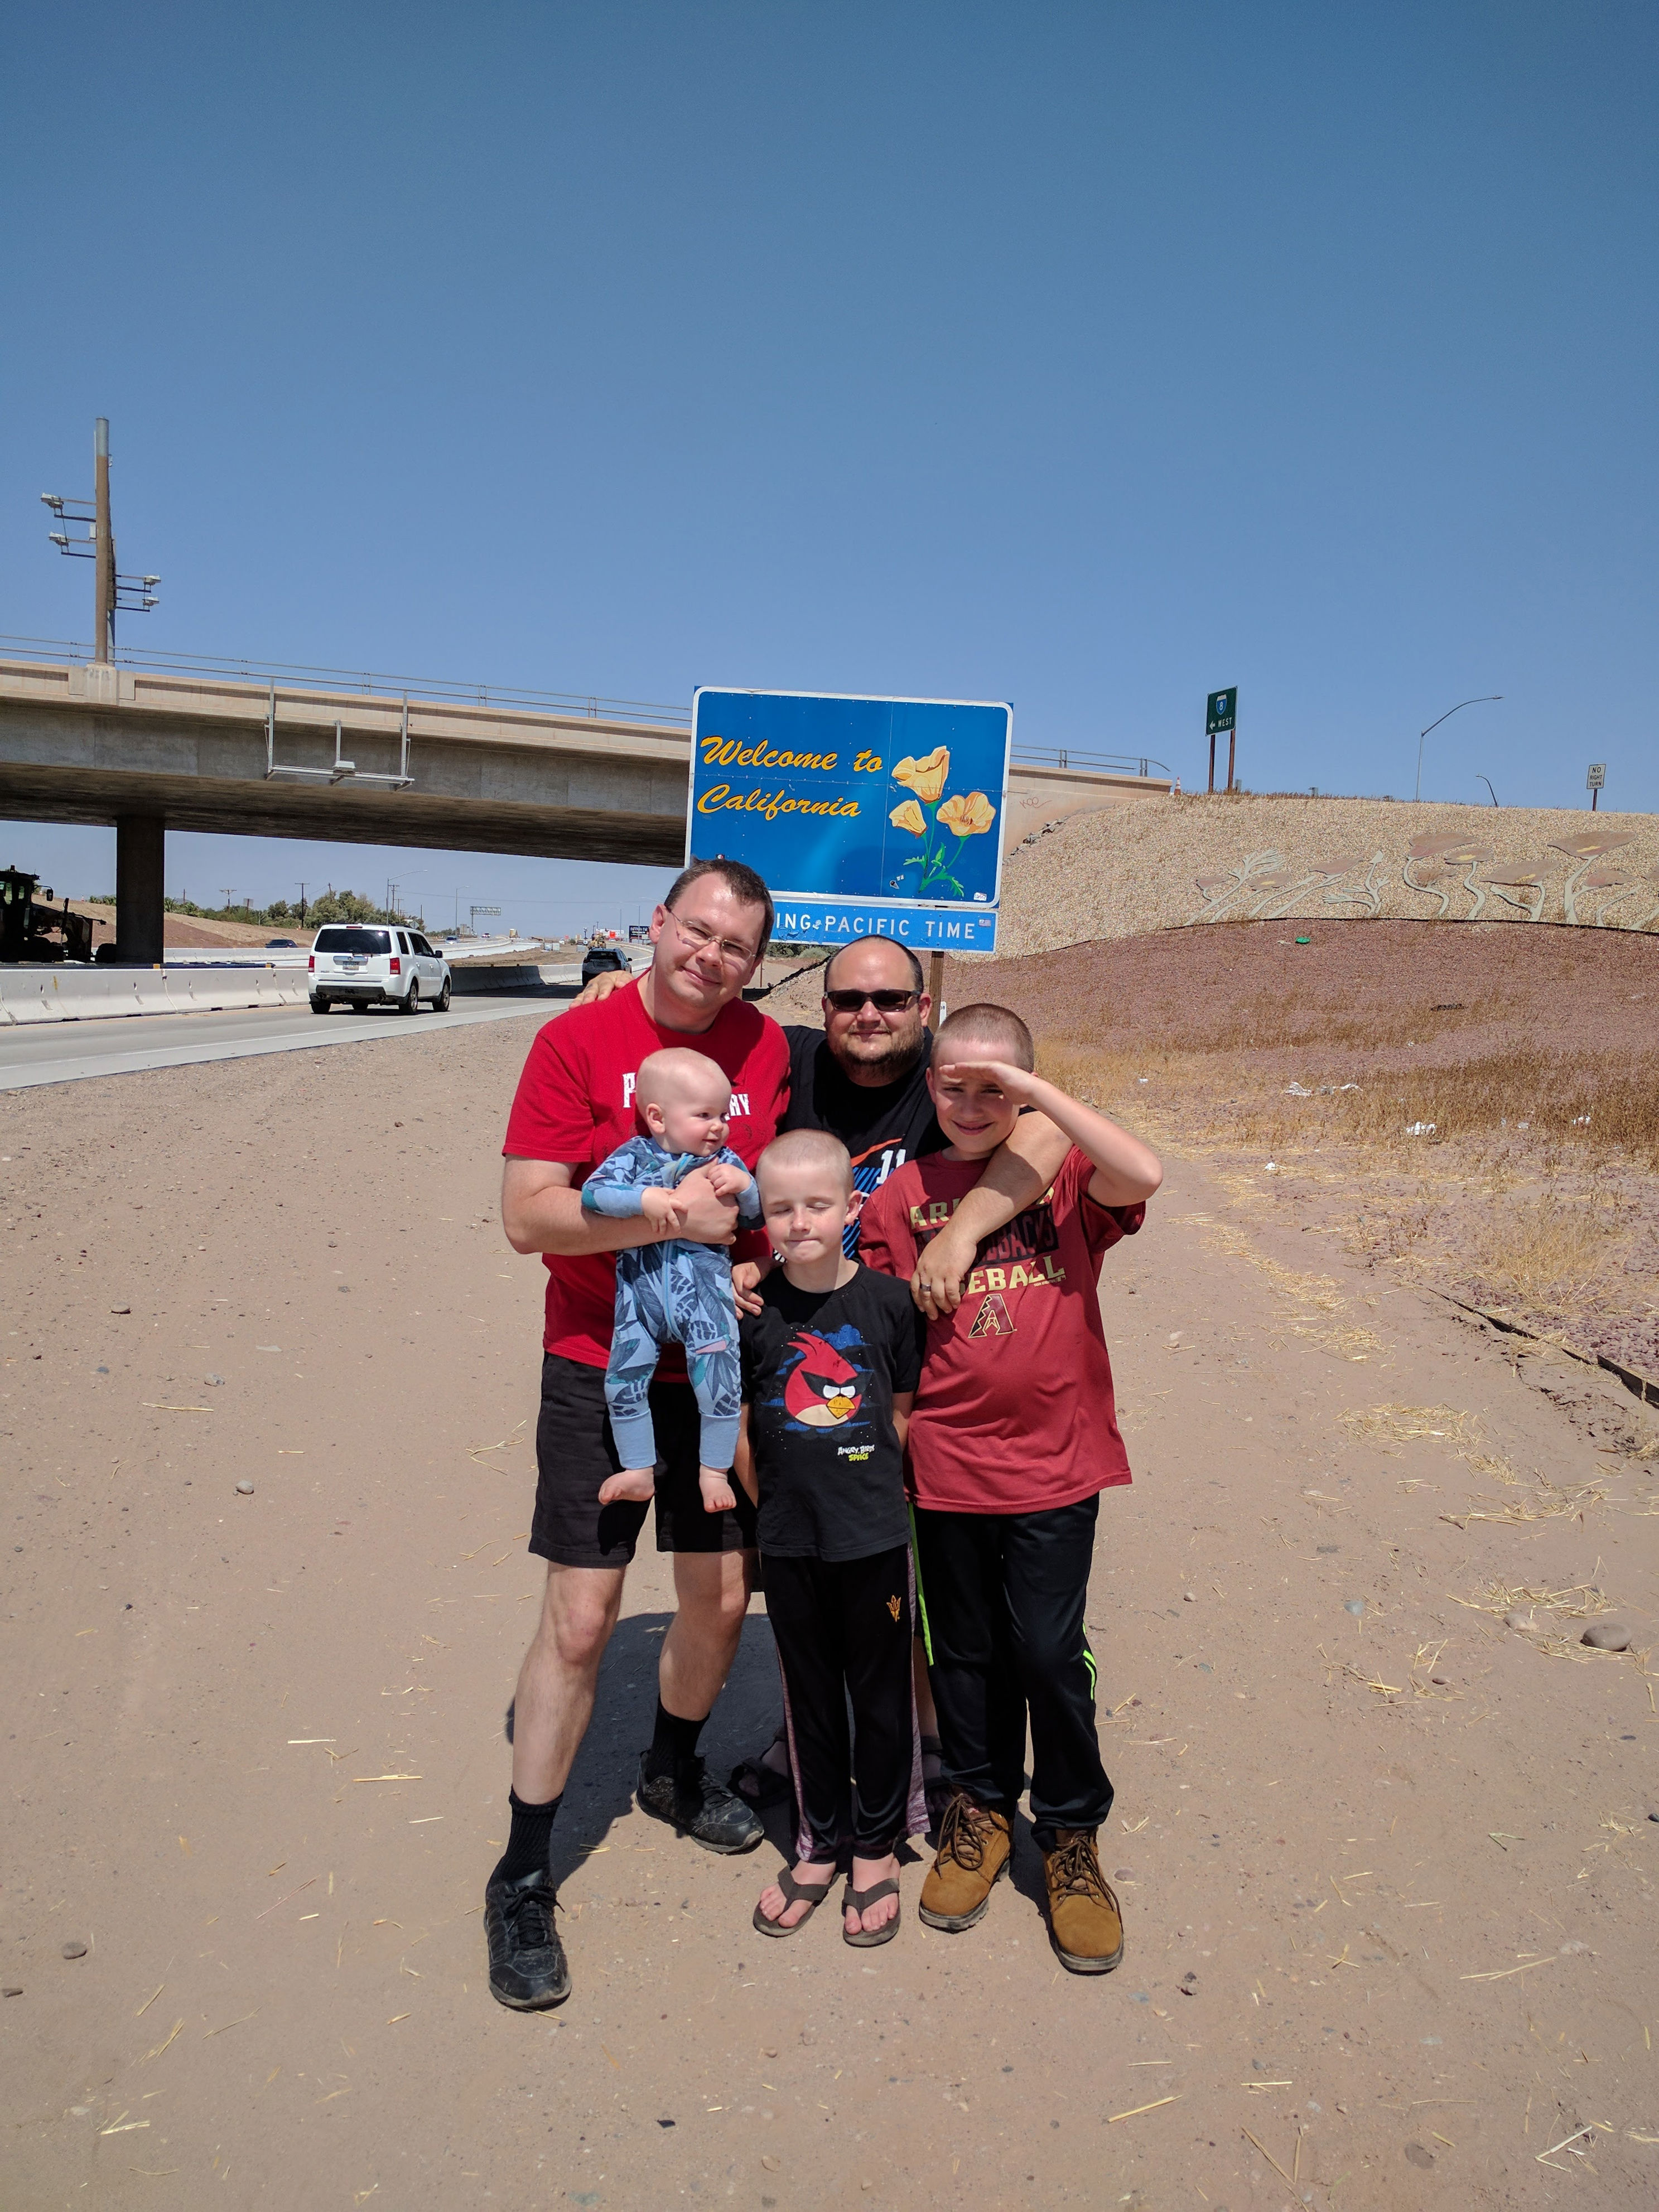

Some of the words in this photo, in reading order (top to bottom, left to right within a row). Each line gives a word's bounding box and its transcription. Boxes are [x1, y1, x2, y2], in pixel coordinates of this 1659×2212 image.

[1219, 702, 1223, 711] 8
[1218, 717, 1232, 727] WEST
[700, 736, 838, 770] Welcome
[853, 748, 883, 773] to
[697, 783, 862, 821] California
[825, 915, 910, 936] PACIFIC
[925, 921, 975, 939] TIME
[959, 1255, 1065, 1295] EBALL
